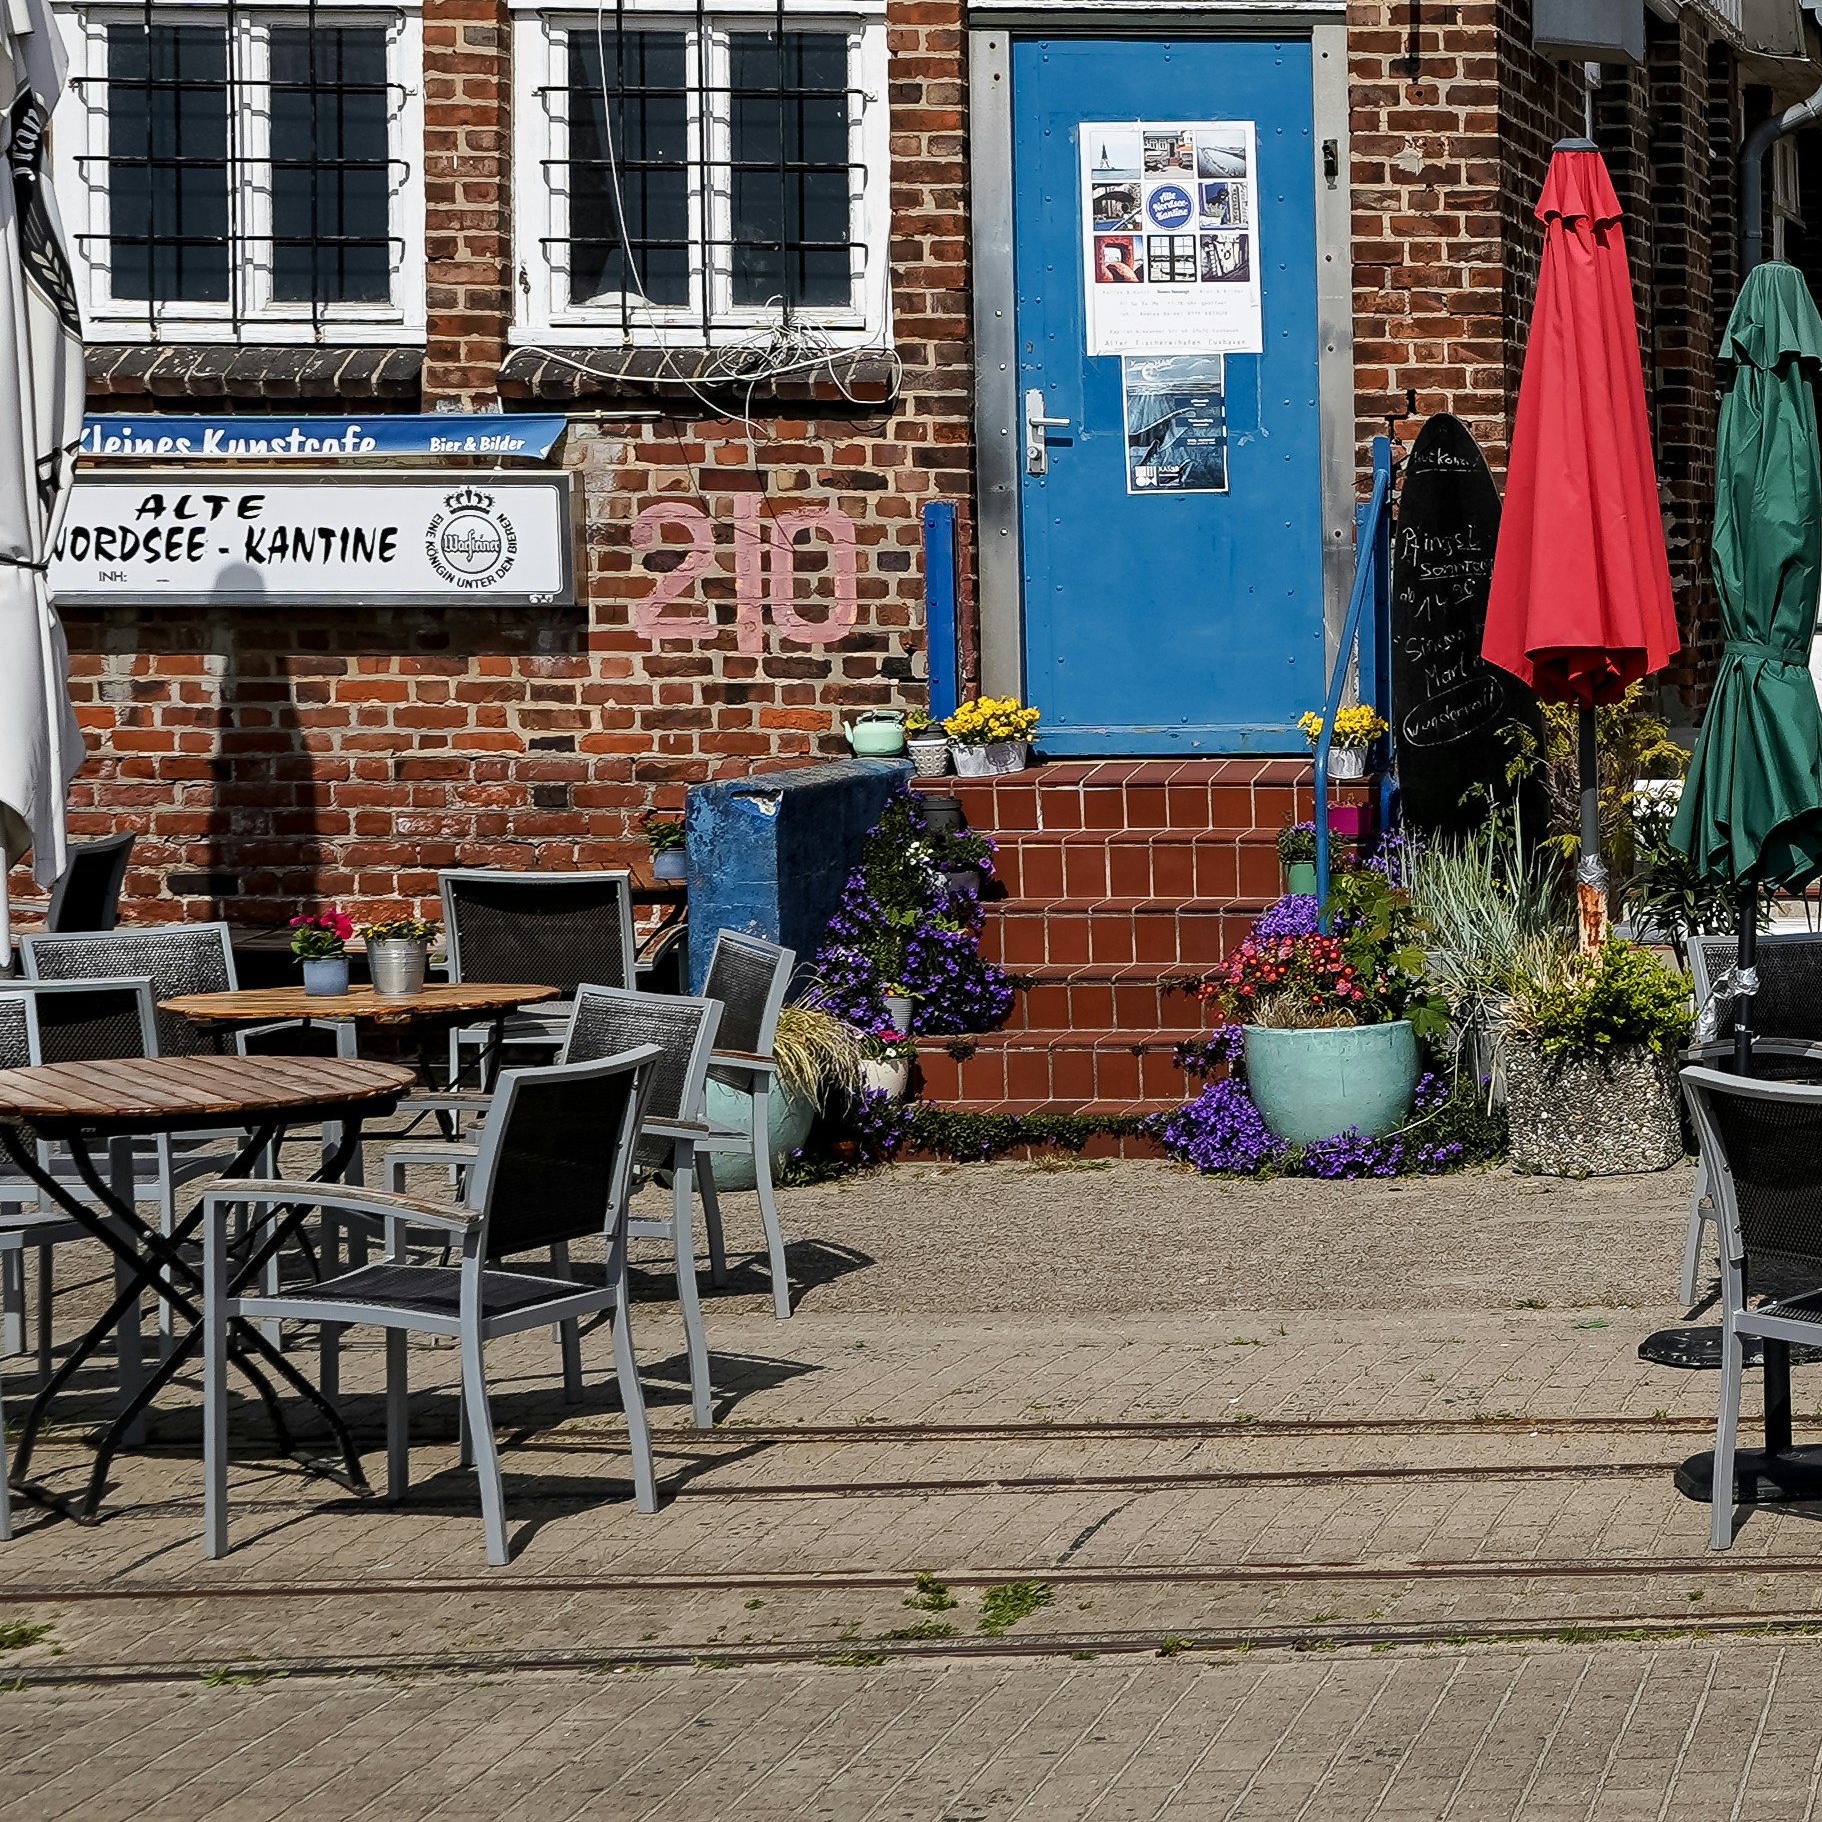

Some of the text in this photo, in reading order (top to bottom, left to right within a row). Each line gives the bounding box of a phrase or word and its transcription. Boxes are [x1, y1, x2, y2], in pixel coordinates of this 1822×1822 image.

[430, 435, 526, 453] Bier & Bilder
[135, 494, 266, 521] ALTE
[244, 524, 399, 565] KANTINE
[425, 513, 518, 589] EINE KÖNIGIN UNTER DEN BIEREN
[98, 571, 128, 583] INH:
[630, 493, 858, 656] 210
